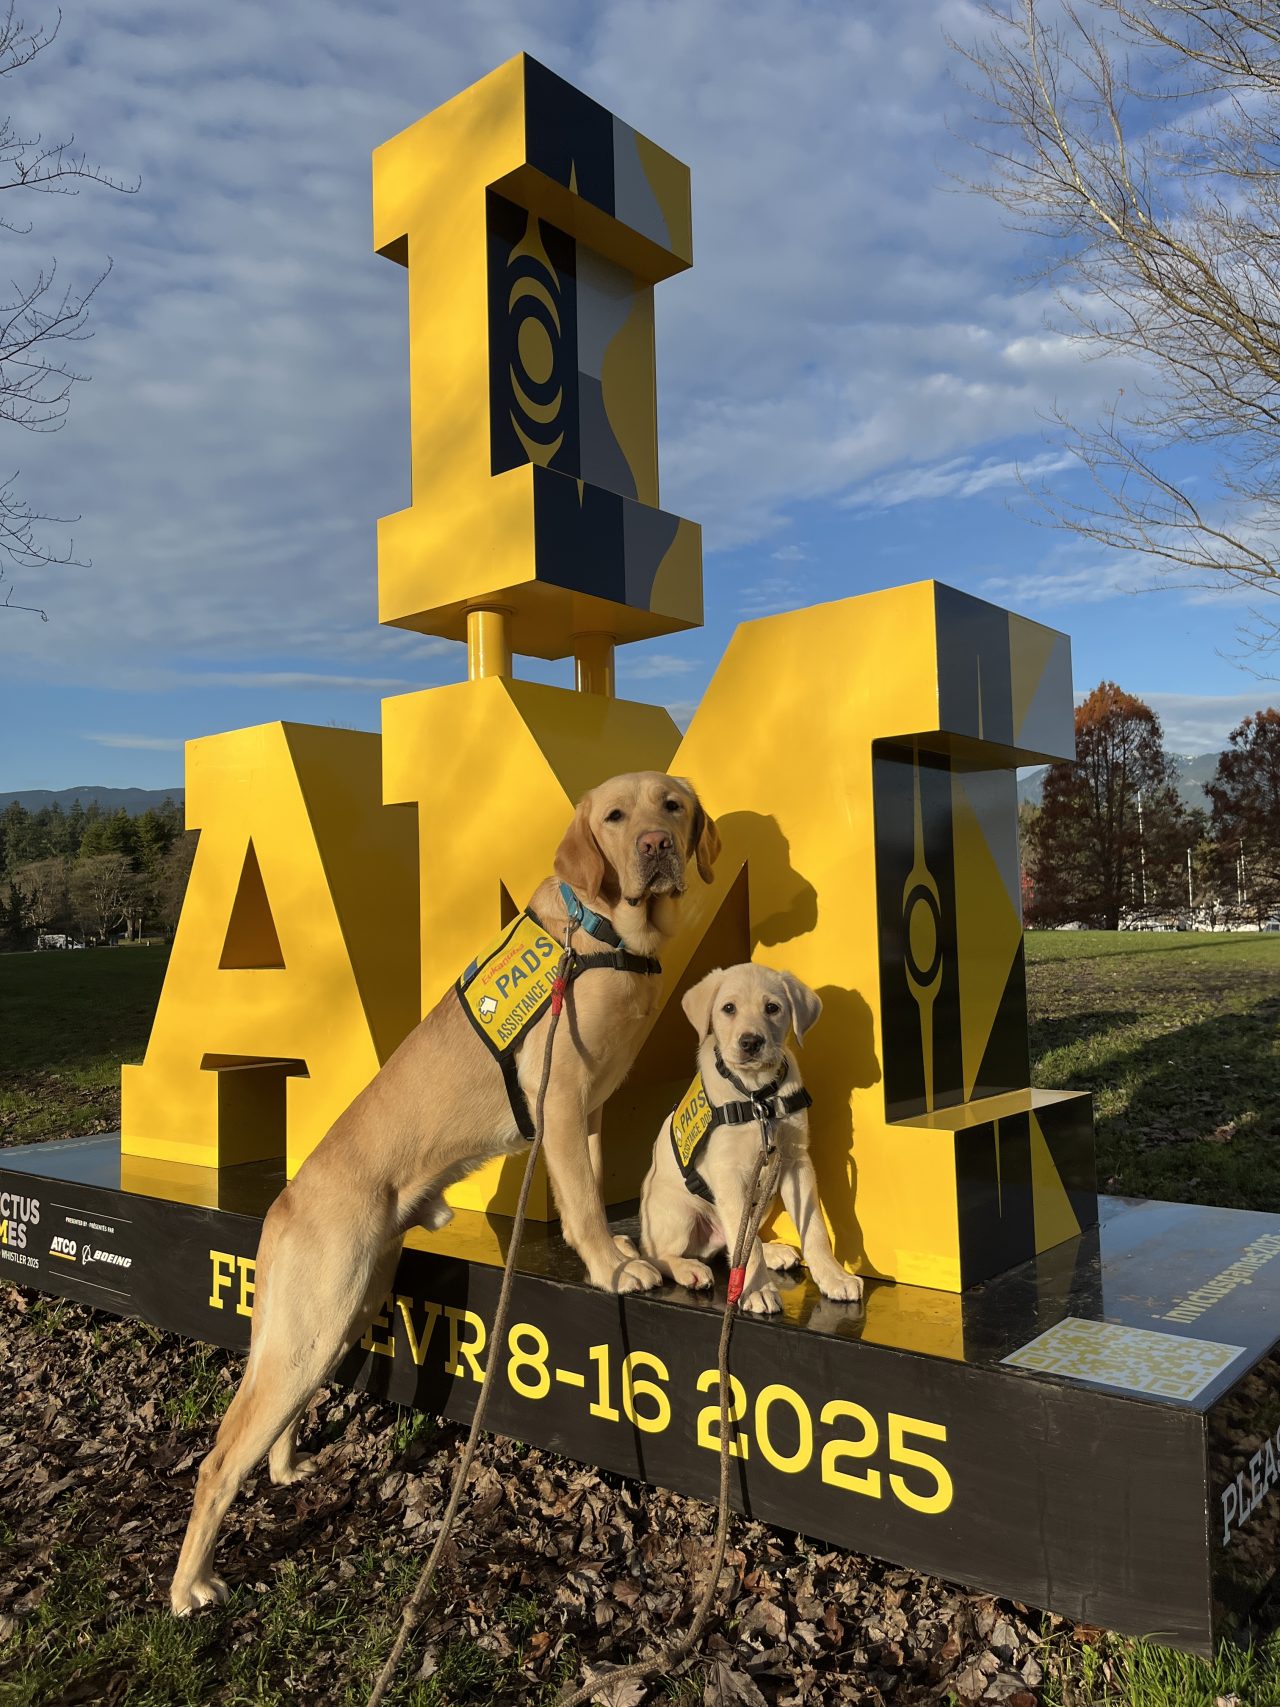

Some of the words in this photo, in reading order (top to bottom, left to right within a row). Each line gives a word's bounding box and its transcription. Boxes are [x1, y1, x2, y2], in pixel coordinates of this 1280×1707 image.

[495, 936, 554, 999] PADS
[497, 980, 548, 1042] ASSISTANCE
[680, 1089, 706, 1132] PADS
[0, 1192, 40, 1225] CTUS
[1, 1249, 27, 1265] WHISTLER
[26, 1257, 40, 1269] 2025
[51, 1236, 77, 1255] ATCO
[93, 1250, 132, 1268] BOEING
[508, 1322, 671, 1433] 8-16
[696, 1369, 953, 1514] 2025
